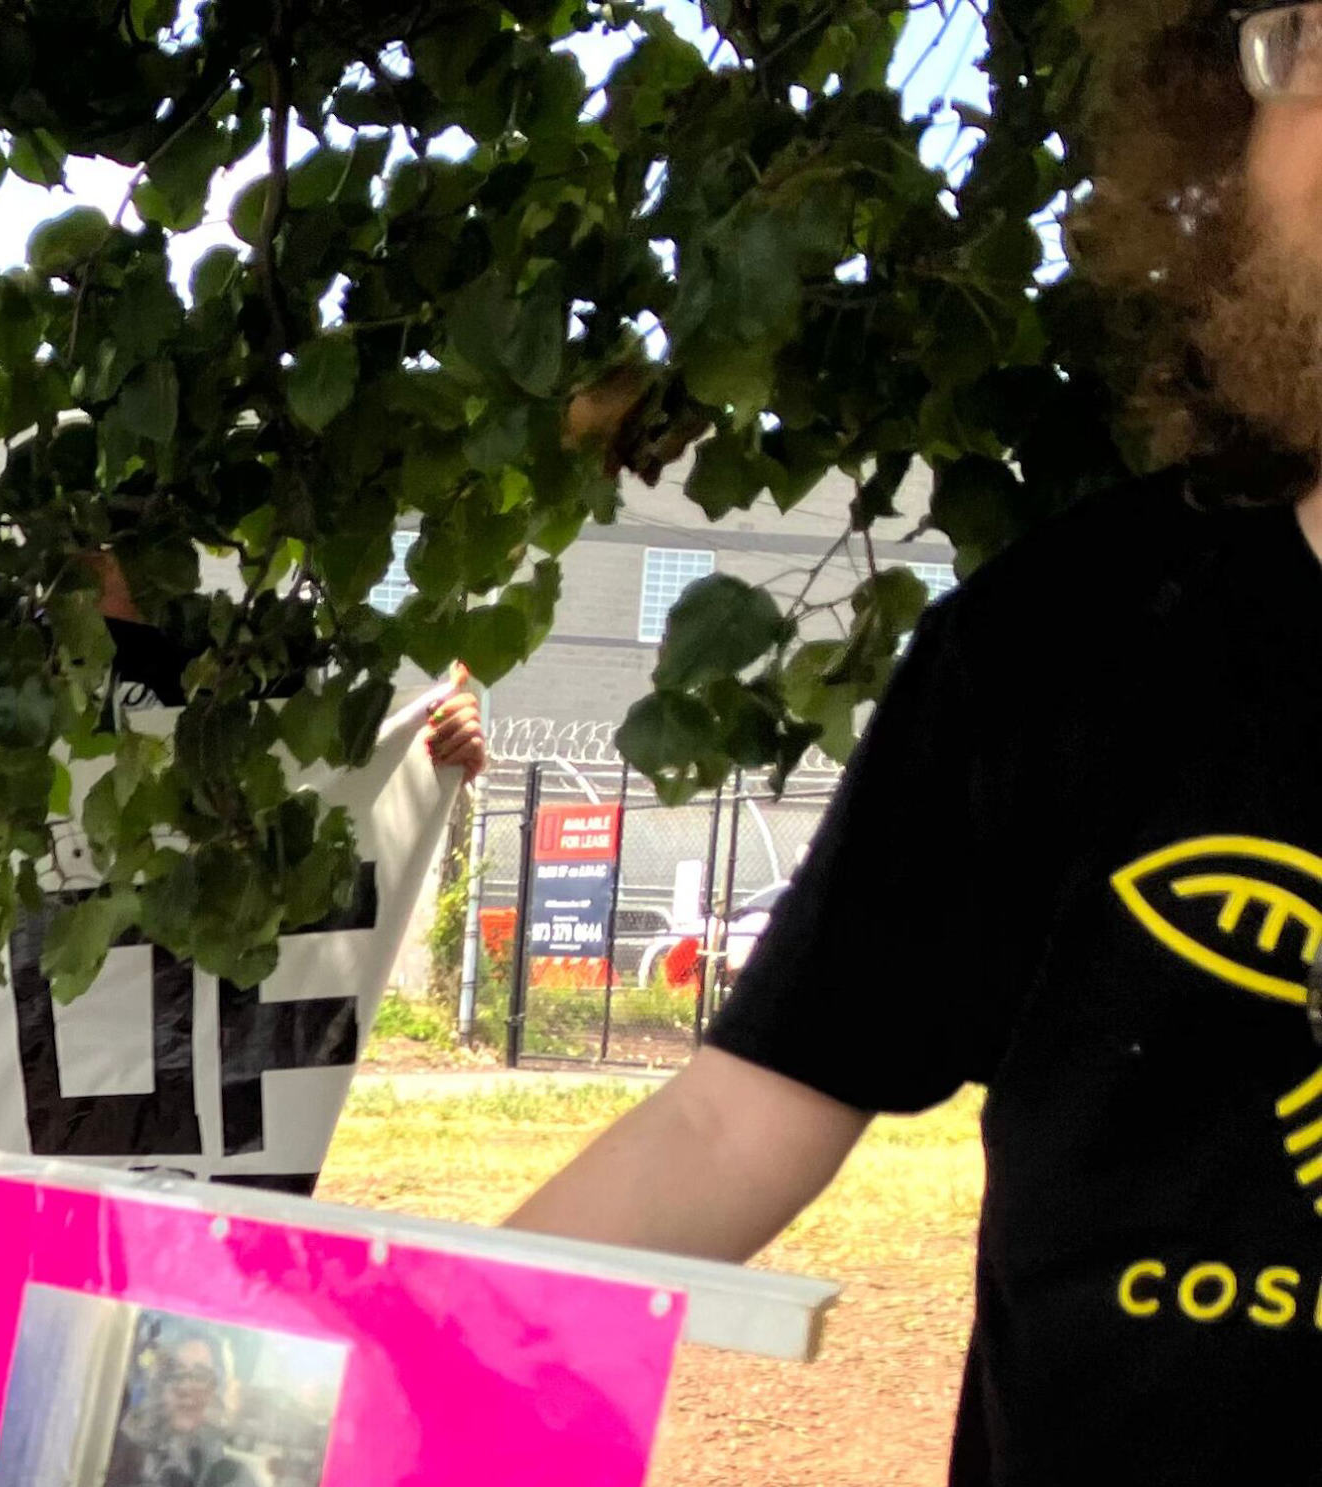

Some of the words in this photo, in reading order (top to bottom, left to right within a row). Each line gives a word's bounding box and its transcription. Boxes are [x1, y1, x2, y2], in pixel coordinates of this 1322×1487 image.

[563, 816, 611, 831] AVAILABLE
[560, 835, 579, 849] FOR
[581, 834, 610, 849] LEASE
[1118, 1258, 1322, 1331] COS
